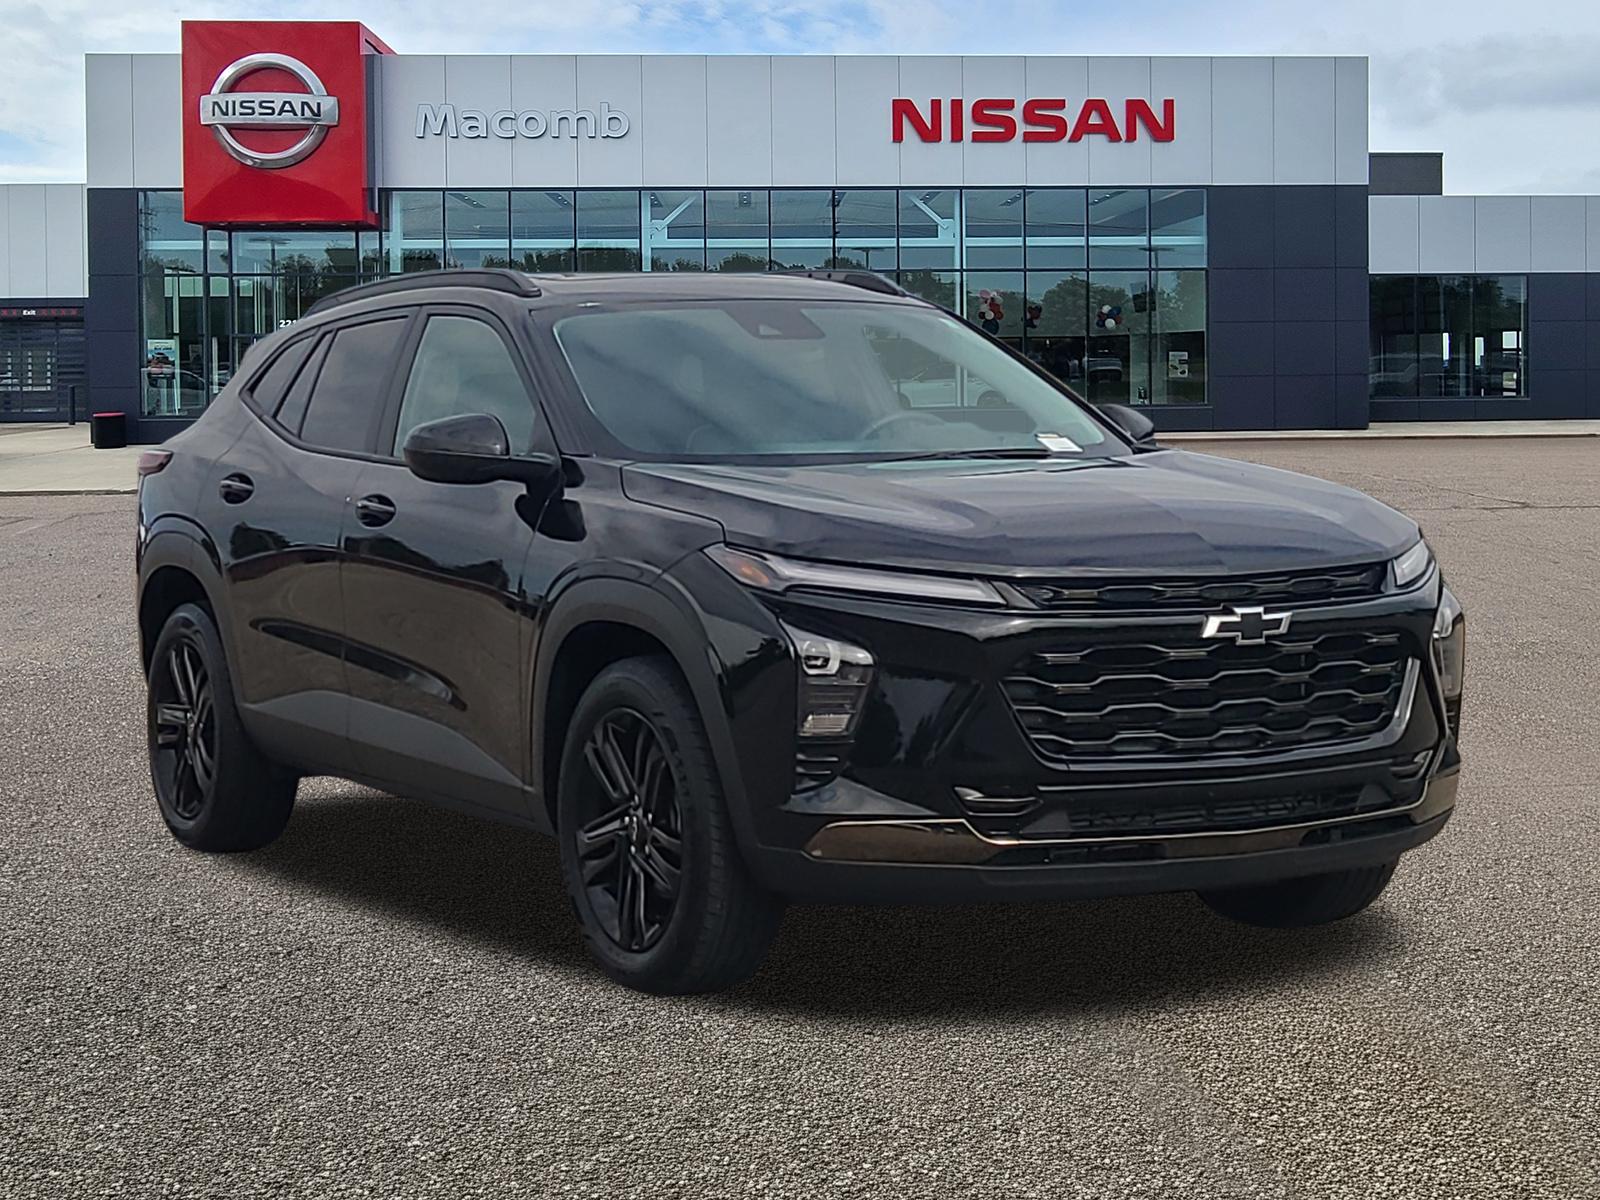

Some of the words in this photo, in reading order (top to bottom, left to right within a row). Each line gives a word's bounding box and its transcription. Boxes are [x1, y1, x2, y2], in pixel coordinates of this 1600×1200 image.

[211, 100, 322, 118] NISSAN
[415, 102, 630, 138] Macomb
[892, 98, 1175, 143] NISSAN
